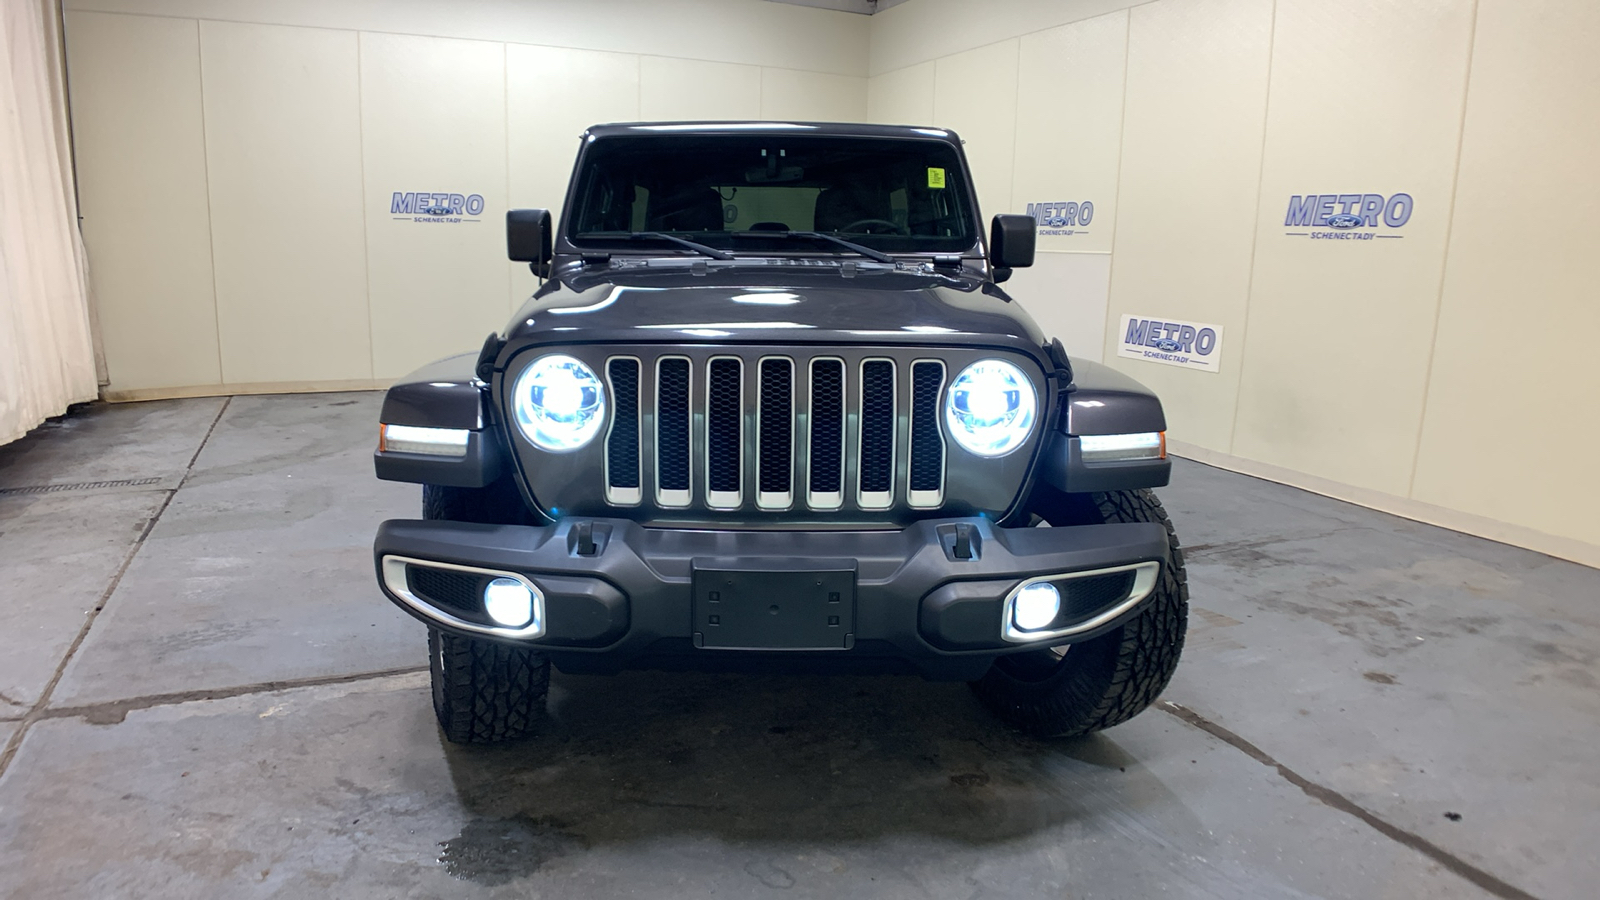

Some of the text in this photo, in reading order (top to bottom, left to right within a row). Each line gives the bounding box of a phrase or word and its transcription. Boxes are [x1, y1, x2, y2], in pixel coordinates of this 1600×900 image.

[390, 192, 485, 216] METRO
[1026, 201, 1094, 227] METRO
[1284, 193, 1414, 228] METRO
[1310, 232, 1377, 240] SCHENECTADY
[1124, 318, 1217, 356] METRO
[1143, 350, 1190, 364] SCHENECTADY
